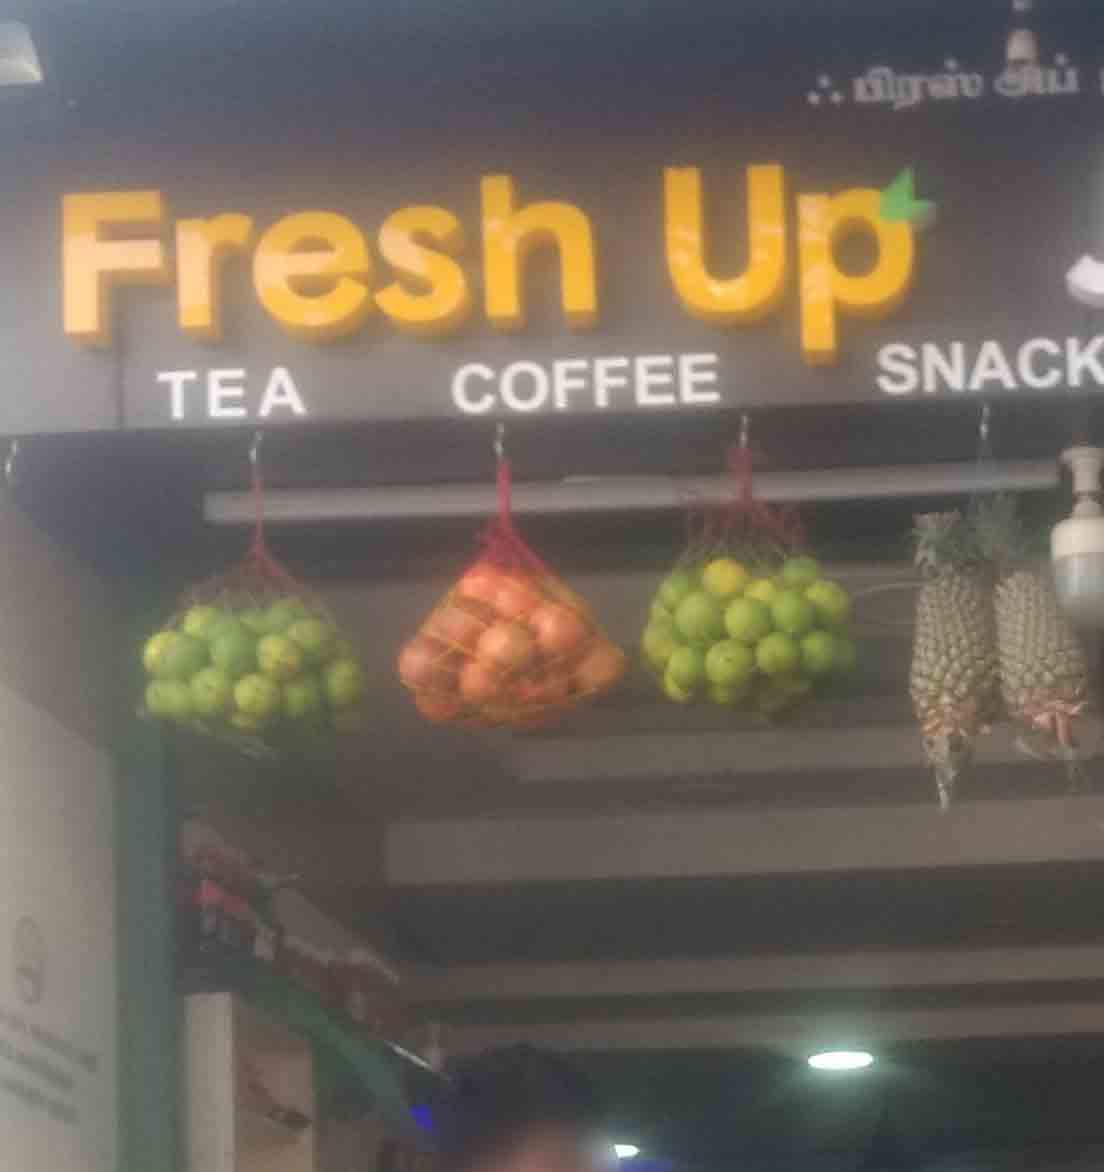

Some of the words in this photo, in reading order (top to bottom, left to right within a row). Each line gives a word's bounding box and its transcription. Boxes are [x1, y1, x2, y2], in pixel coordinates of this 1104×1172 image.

[62, 174, 598, 347] Fresh
[663, 164, 916, 362] Up
[156, 368, 307, 419] TEA
[451, 353, 720, 415] COFFEE
